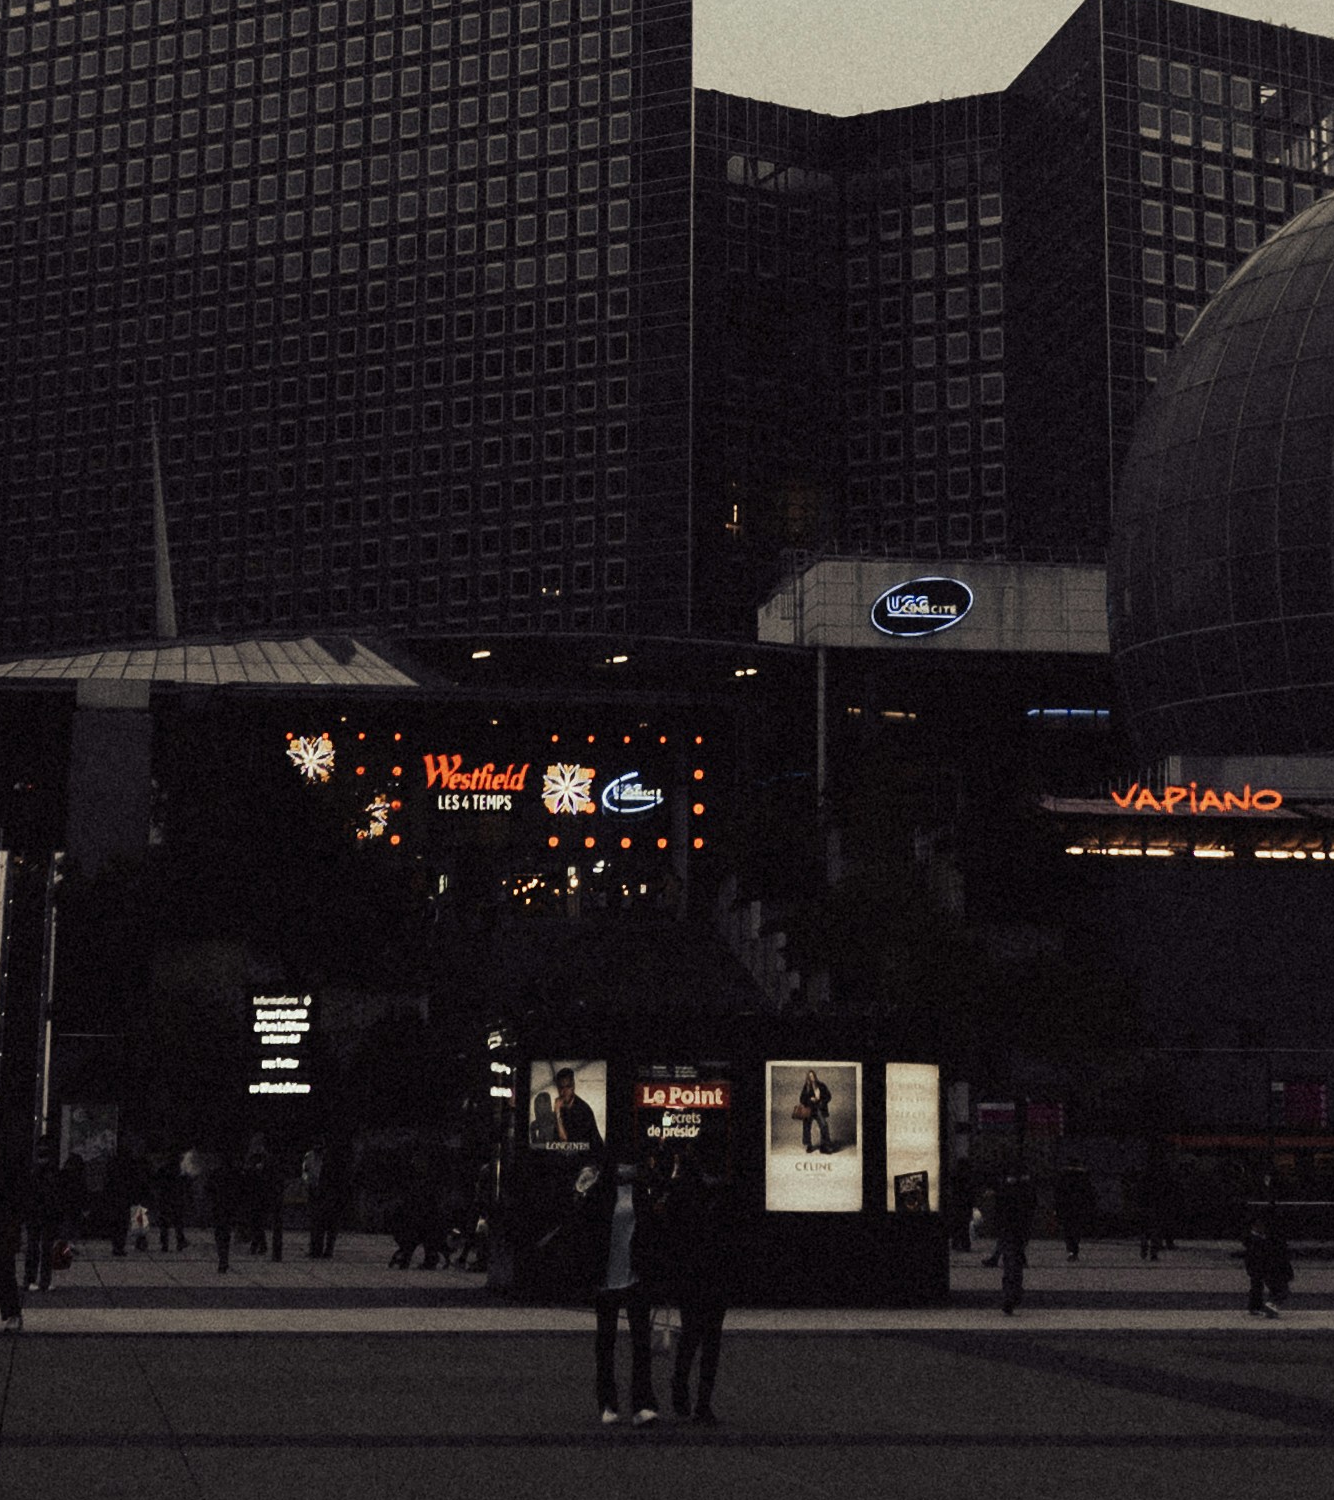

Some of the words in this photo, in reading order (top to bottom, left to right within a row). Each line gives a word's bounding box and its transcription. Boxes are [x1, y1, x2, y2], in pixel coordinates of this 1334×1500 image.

[423, 754, 530, 791] Westfield
[438, 795, 459, 811] LES
[462, 795, 468, 811] 4
[473, 795, 512, 811] TEMPS
[643, 1086, 666, 1104] Le
[669, 1084, 723, 1105] Point
[647, 1124, 661, 1137] de
